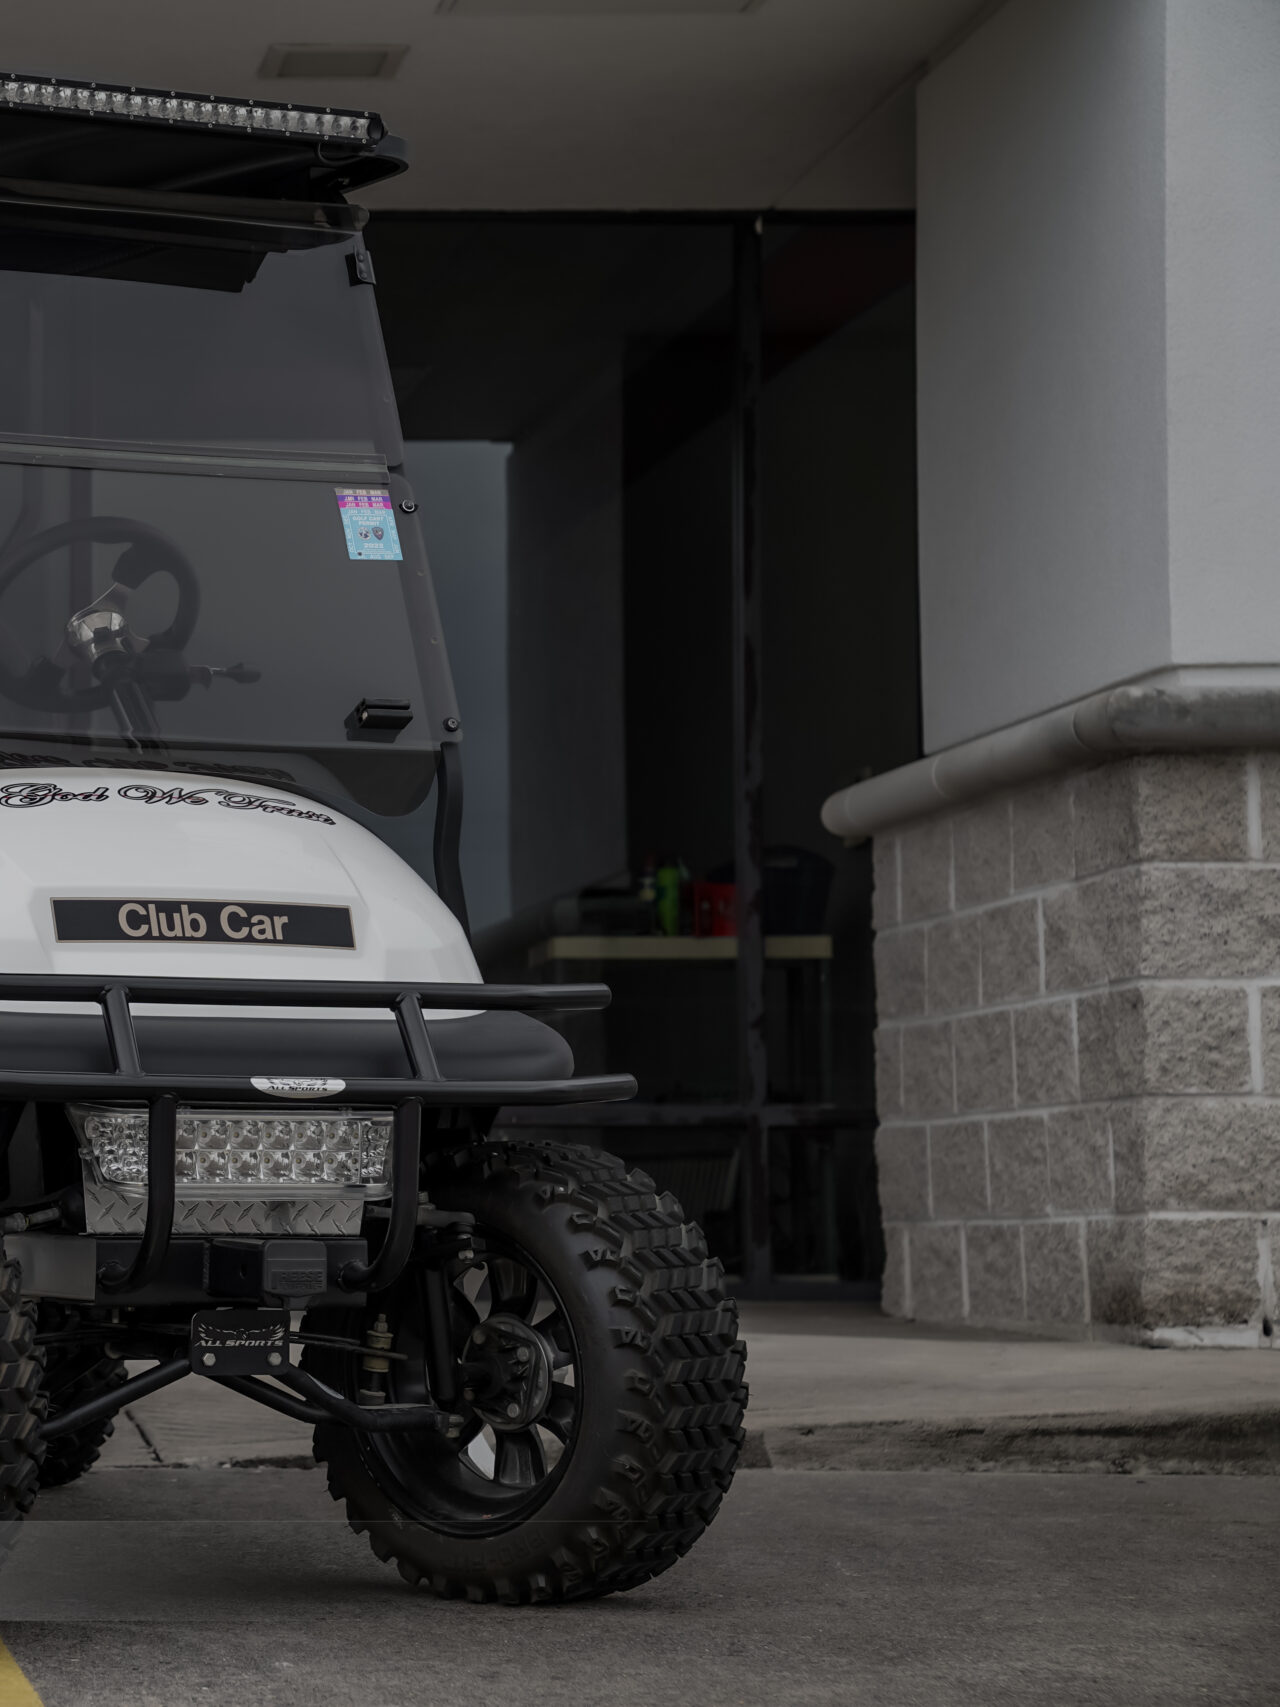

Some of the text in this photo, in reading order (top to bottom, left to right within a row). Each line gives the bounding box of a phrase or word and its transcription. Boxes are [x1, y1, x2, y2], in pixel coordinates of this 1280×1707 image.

[118, 784, 209, 805] We
[198, 788, 337, 825] Trust
[118, 902, 289, 940] Club Car
[225, 1339, 284, 1347] SPORTS
